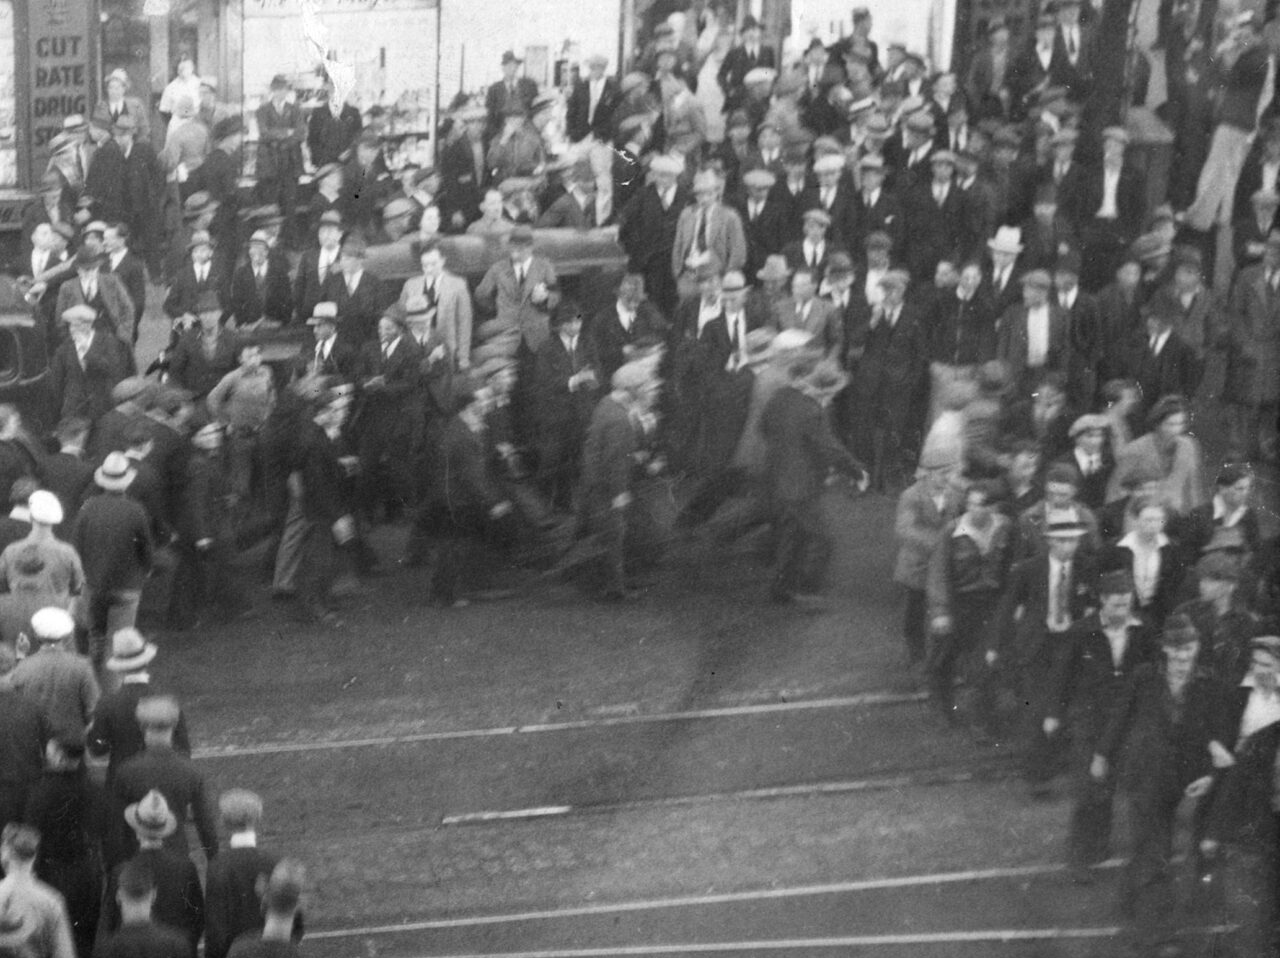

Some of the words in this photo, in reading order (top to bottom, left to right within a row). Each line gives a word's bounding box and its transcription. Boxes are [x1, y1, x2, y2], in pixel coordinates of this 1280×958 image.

[36, 35, 82, 58] CUT
[35, 63, 85, 88] RATE
[34, 94, 86, 118] DRUG
